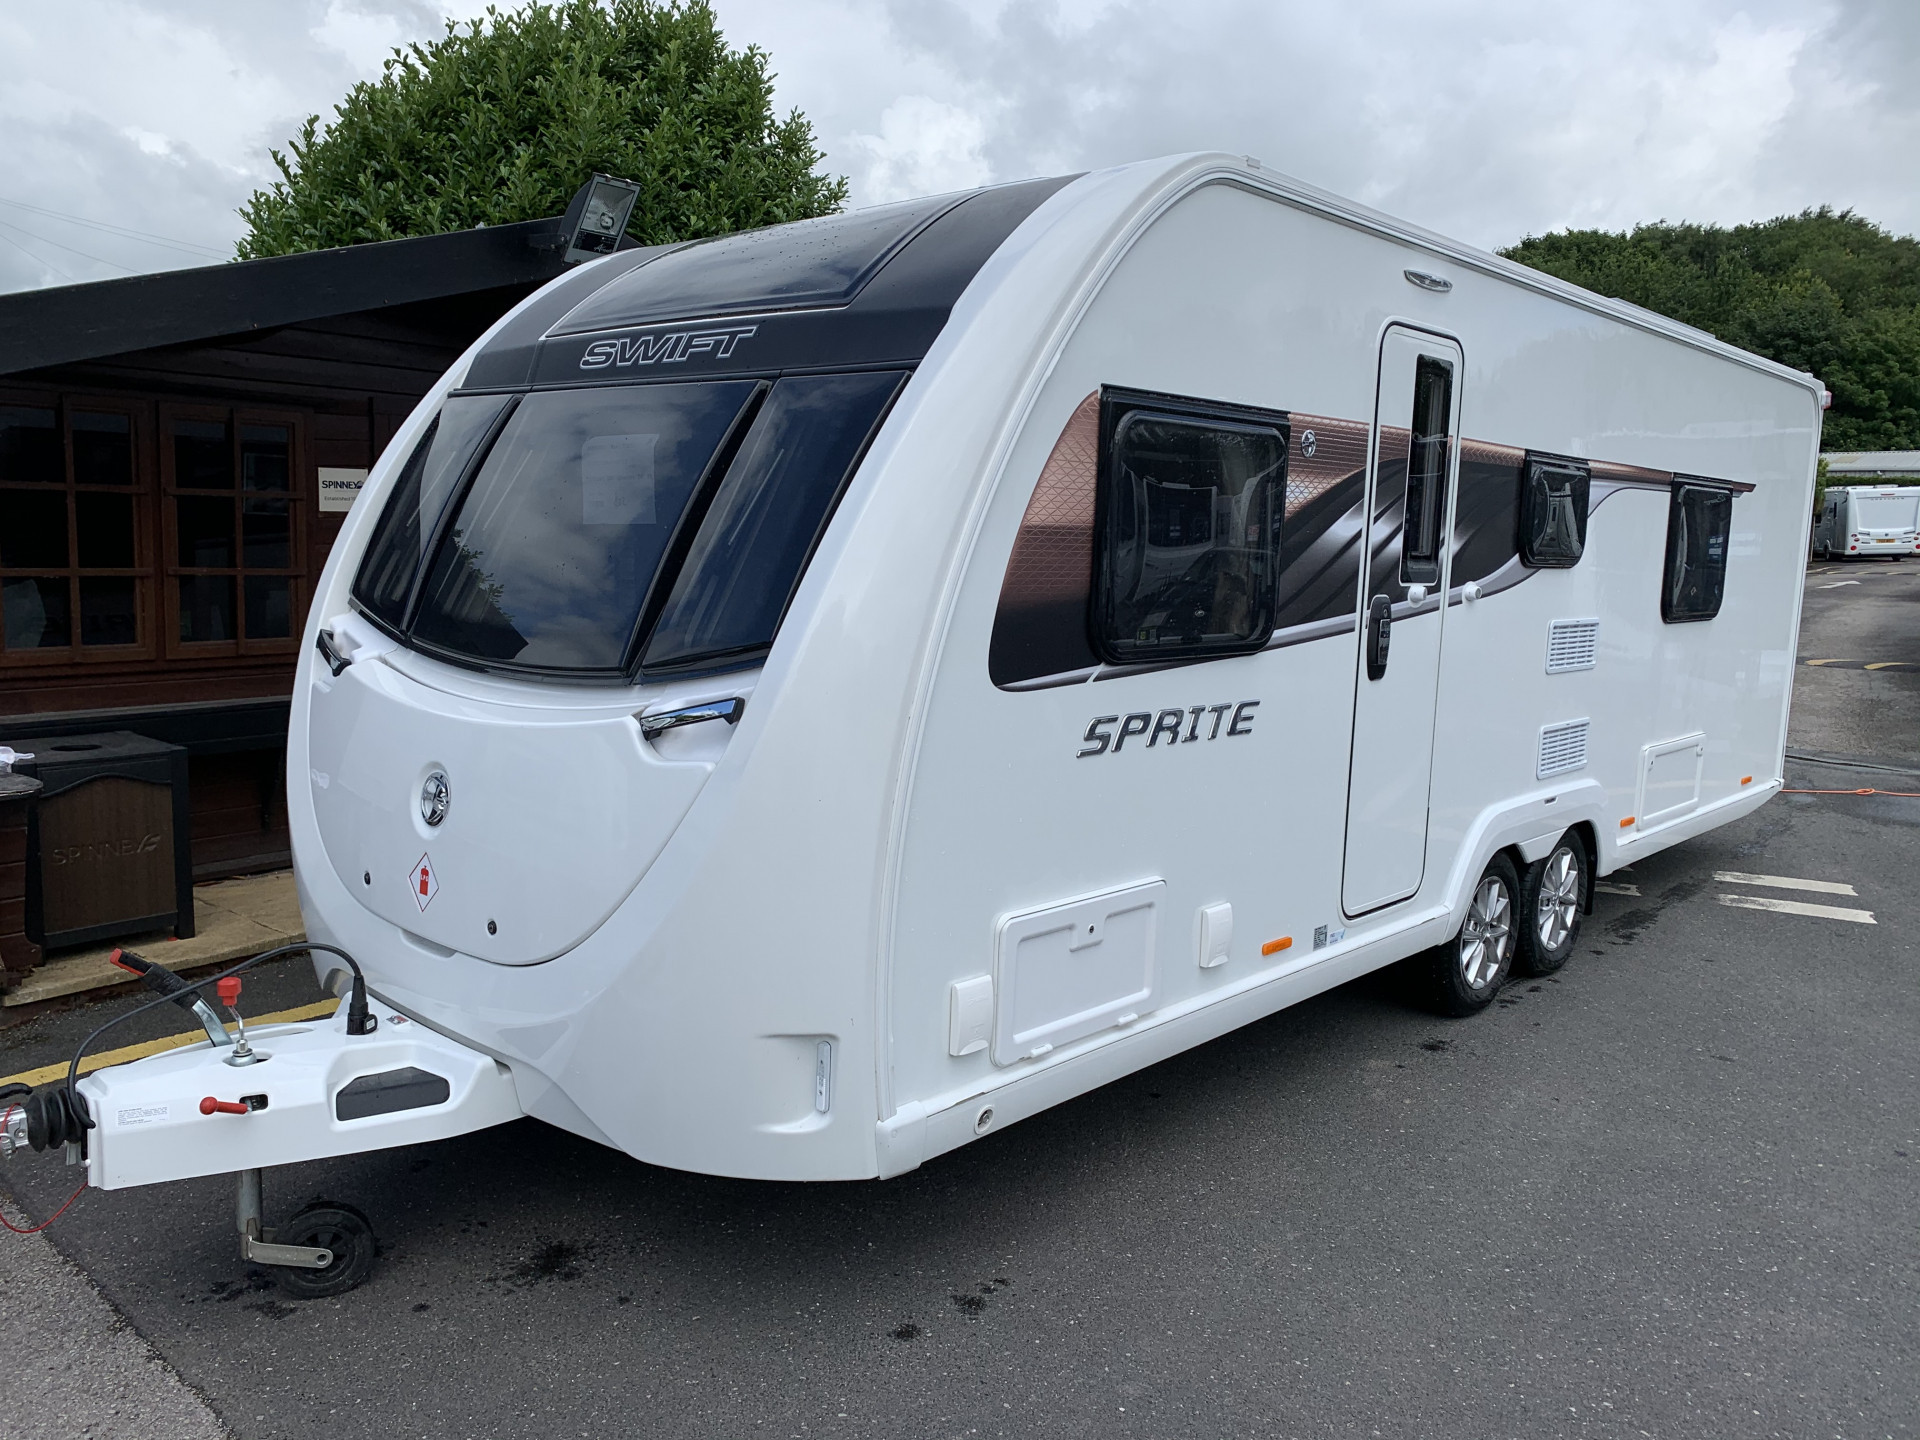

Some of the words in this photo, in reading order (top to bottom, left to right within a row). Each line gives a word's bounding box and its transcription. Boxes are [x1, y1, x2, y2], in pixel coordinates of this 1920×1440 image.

[580, 325, 759, 369] SWIFT
[321, 480, 359, 489] SPINNEY
[1076, 699, 1261, 759] SPRITE
